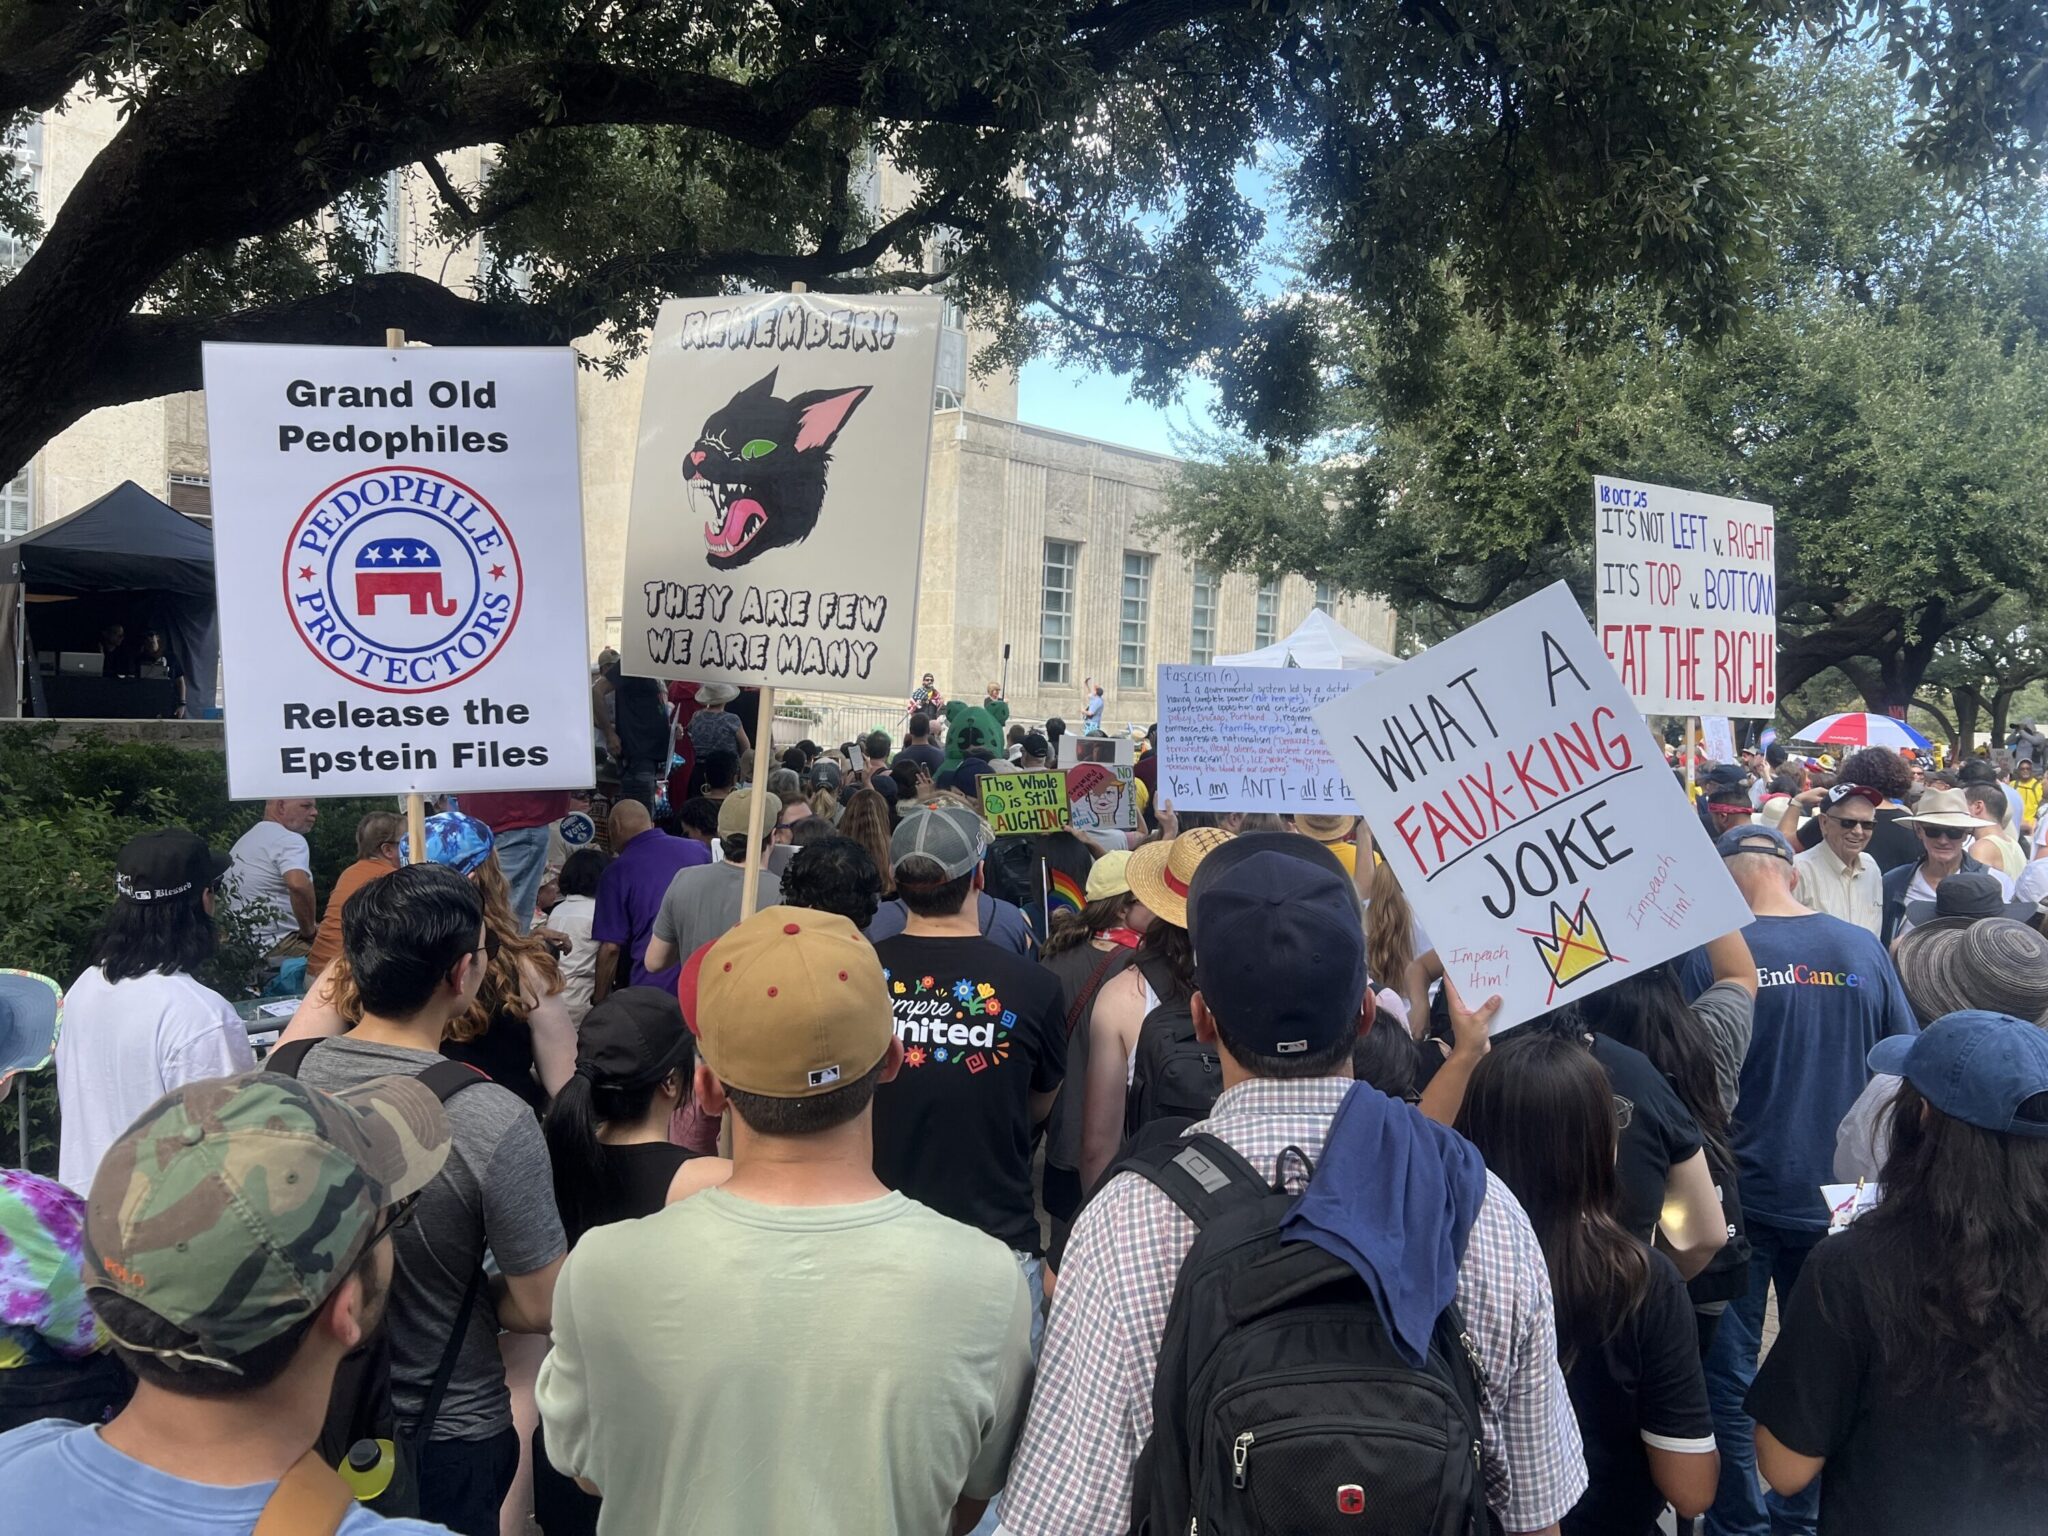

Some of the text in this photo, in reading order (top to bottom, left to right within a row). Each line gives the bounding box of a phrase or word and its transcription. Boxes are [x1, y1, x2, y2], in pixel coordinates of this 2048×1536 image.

[682, 305, 898, 352] REMEMBER!
[286, 379, 496, 408] Grand Old
[279, 425, 509, 459] Pedophiles
[1600, 485, 1648, 508] 18 OCT 25
[299, 475, 504, 557] PEDOPHILE
[1602, 508, 1773, 561] IT'S NOT LEFT v. RIGHT
[1603, 561, 1775, 616] IT'S TOP v. BOTTOM
[644, 581, 887, 633] THEY ARE FEW
[296, 589, 511, 684] PROTECTORS
[647, 627, 877, 680] WE ARE MANY
[1603, 624, 1775, 705] EAT THE RICH!
[1204, 683, 1253, 697] governmental
[1257, 683, 1286, 697] system
[1303, 684, 1312, 697] by
[1326, 682, 1352, 693] dictat
[1220, 668, 1240, 687] (n)
[283, 698, 530, 730] Release the
[1256, 703, 1270, 711] and
[1274, 703, 1311, 713] criticism
[1353, 630, 1591, 793] WHAT A
[1165, 735, 1176, 743] an
[1222, 733, 1271, 744] nationalism
[1294, 725, 1308, 734] and
[280, 741, 549, 779] Epstein Files
[1117, 767, 1132, 779] NO
[1166, 754, 1190, 763] often
[982, 774, 1058, 792] The Whole
[1008, 789, 1058, 808] is Still
[1169, 775, 1194, 798] Yes,
[1196, 777, 1203, 796] I
[1208, 782, 1230, 798] am
[1322, 778, 1335, 797] of
[1394, 705, 1633, 876] FAUX-KING
[1481, 800, 1634, 919] JOKE
[154, 882, 192, 899] Blessed
[1626, 854, 1677, 931] Impeach
[1660, 883, 1695, 930] Him!
[1449, 944, 1509, 972] Impeach
[1470, 964, 1510, 989] Him!
